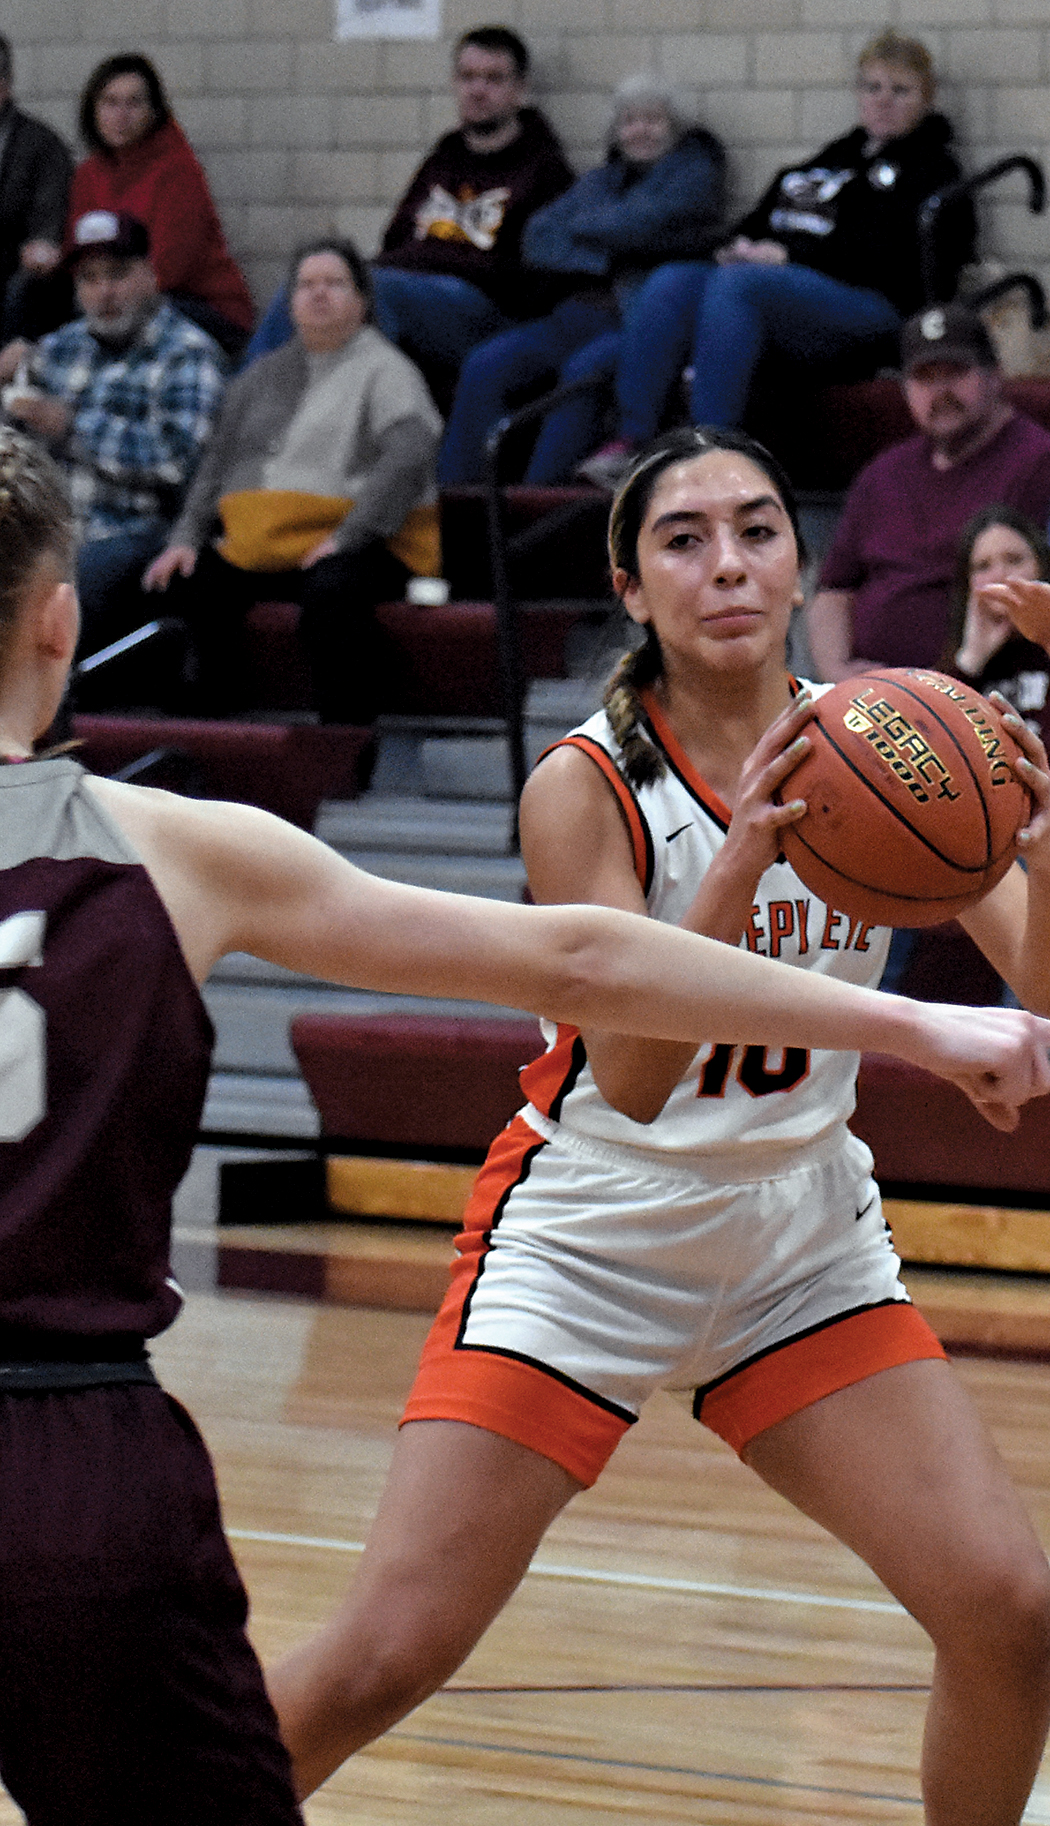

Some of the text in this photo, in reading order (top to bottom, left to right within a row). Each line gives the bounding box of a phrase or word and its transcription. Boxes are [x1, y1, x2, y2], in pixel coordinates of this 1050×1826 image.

[849, 687, 962, 802] LEGACY
[864, 728, 931, 805] 1000
[746, 899, 810, 958] EPY
